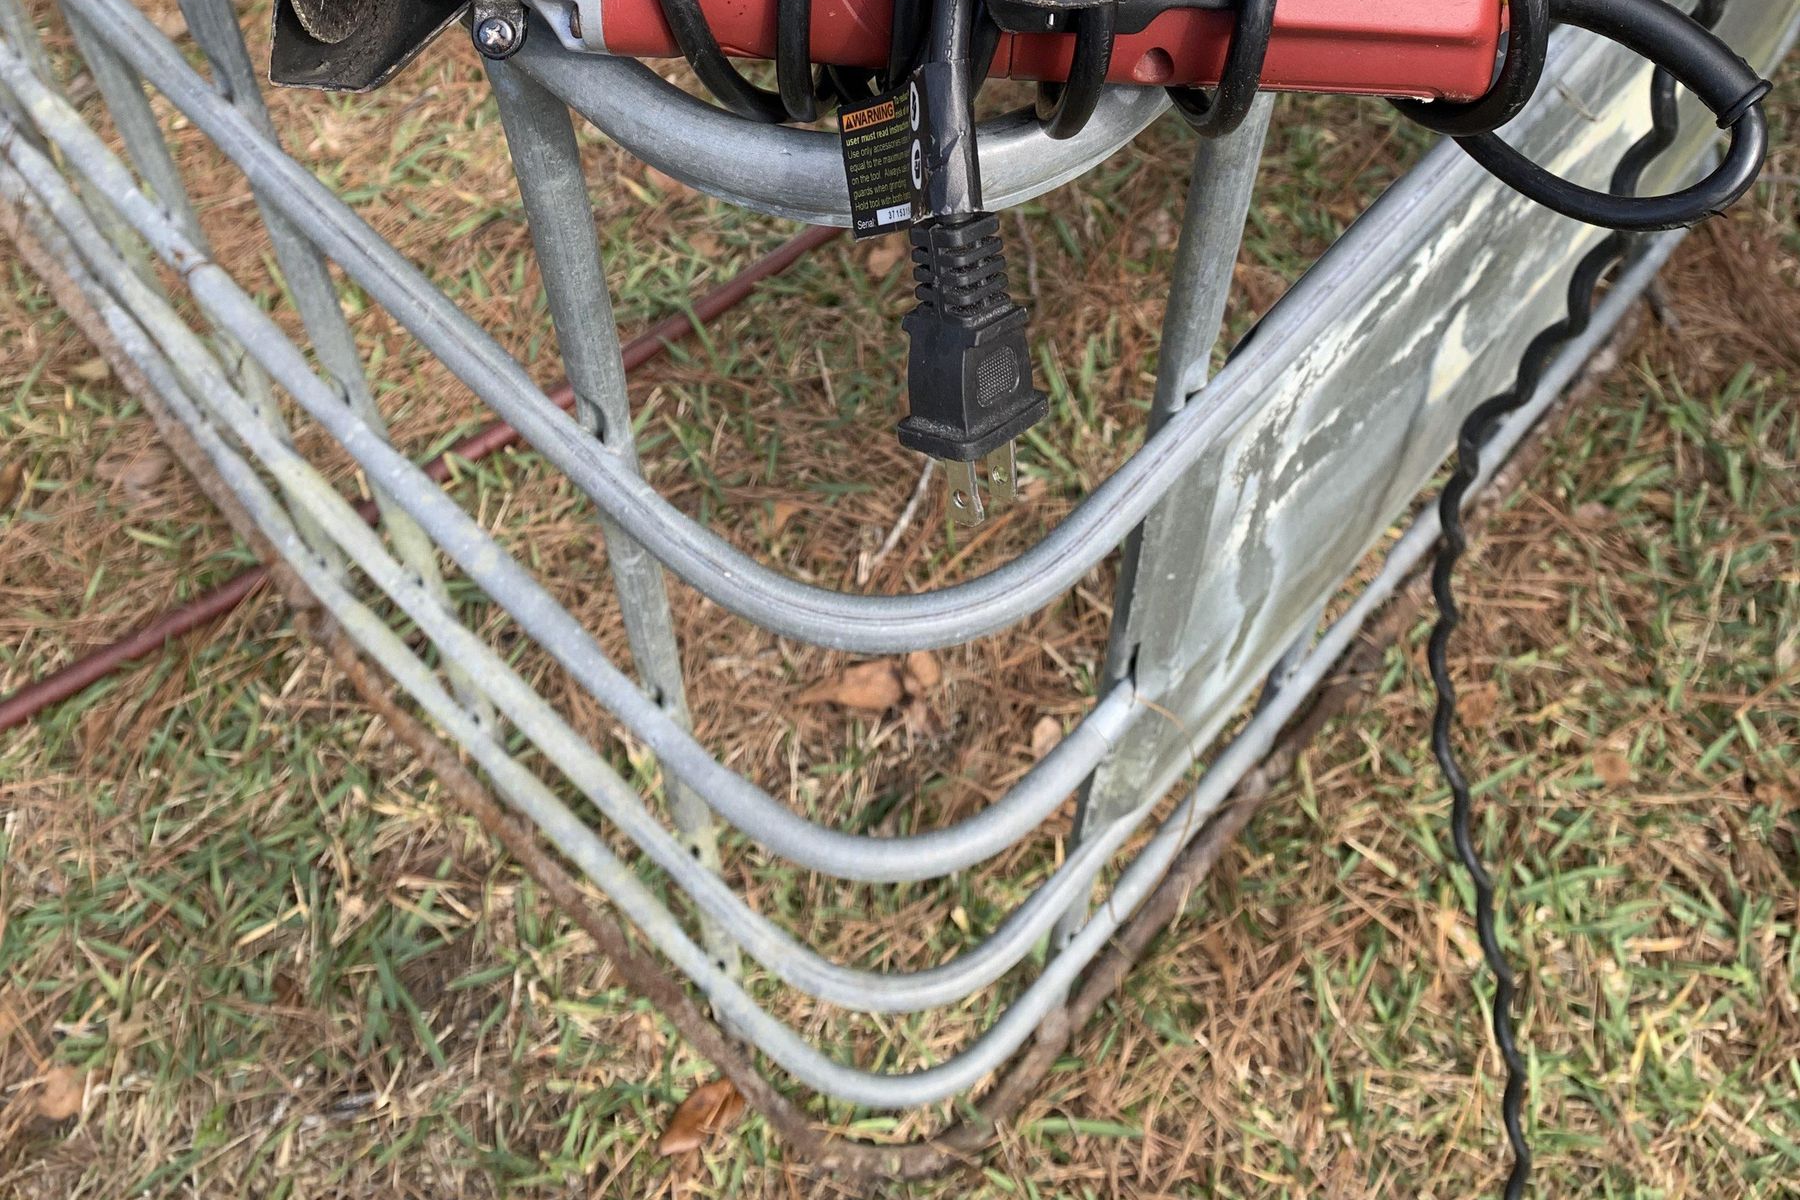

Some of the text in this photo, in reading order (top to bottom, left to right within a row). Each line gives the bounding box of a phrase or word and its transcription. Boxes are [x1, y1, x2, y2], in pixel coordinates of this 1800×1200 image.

[853, 104, 894, 128] WARNING
[846, 136, 859, 146] user
[861, 132, 876, 143] must
[876, 128, 888, 139] read
[848, 150, 859, 160] Use
[861, 147, 872, 157] only
[850, 158, 882, 173] equal to the
[852, 178, 859, 186] on
[860, 174, 870, 183] the
[854, 188, 873, 200] guards
[874, 184, 888, 193] when
[855, 201, 869, 211] Hold
[870, 198, 880, 208] tool
